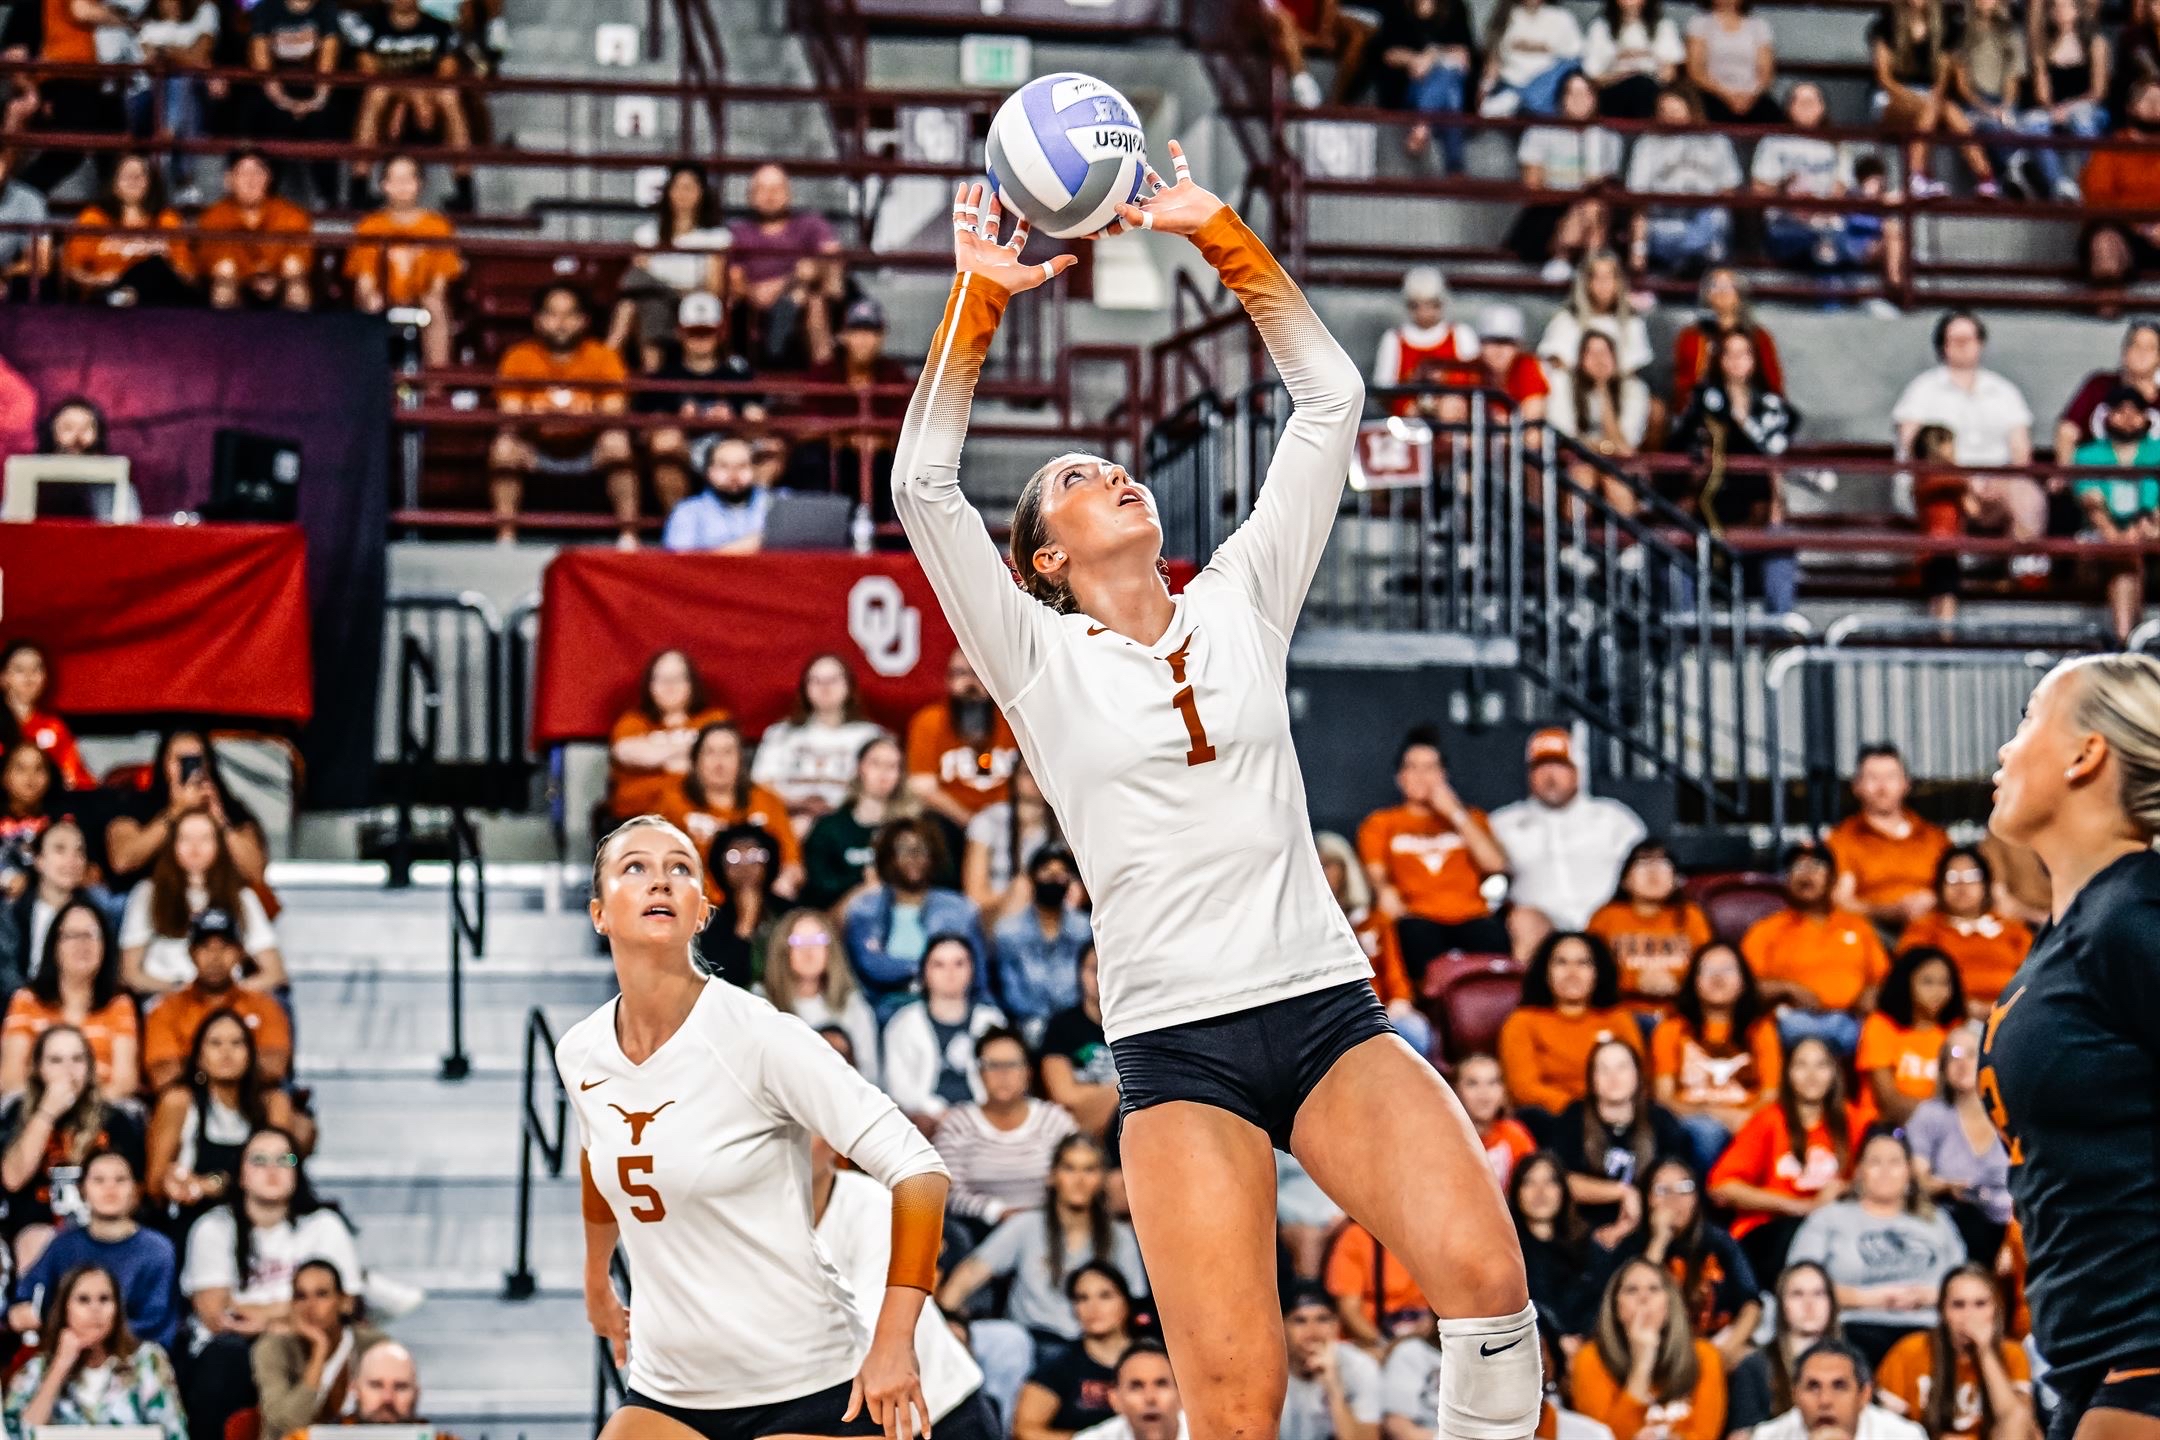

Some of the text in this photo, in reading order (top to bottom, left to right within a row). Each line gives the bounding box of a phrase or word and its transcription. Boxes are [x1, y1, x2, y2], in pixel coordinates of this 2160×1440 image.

[847, 576, 922, 677] OU
[1172, 685, 1217, 767] 1
[617, 1155, 667, 1223] 5
